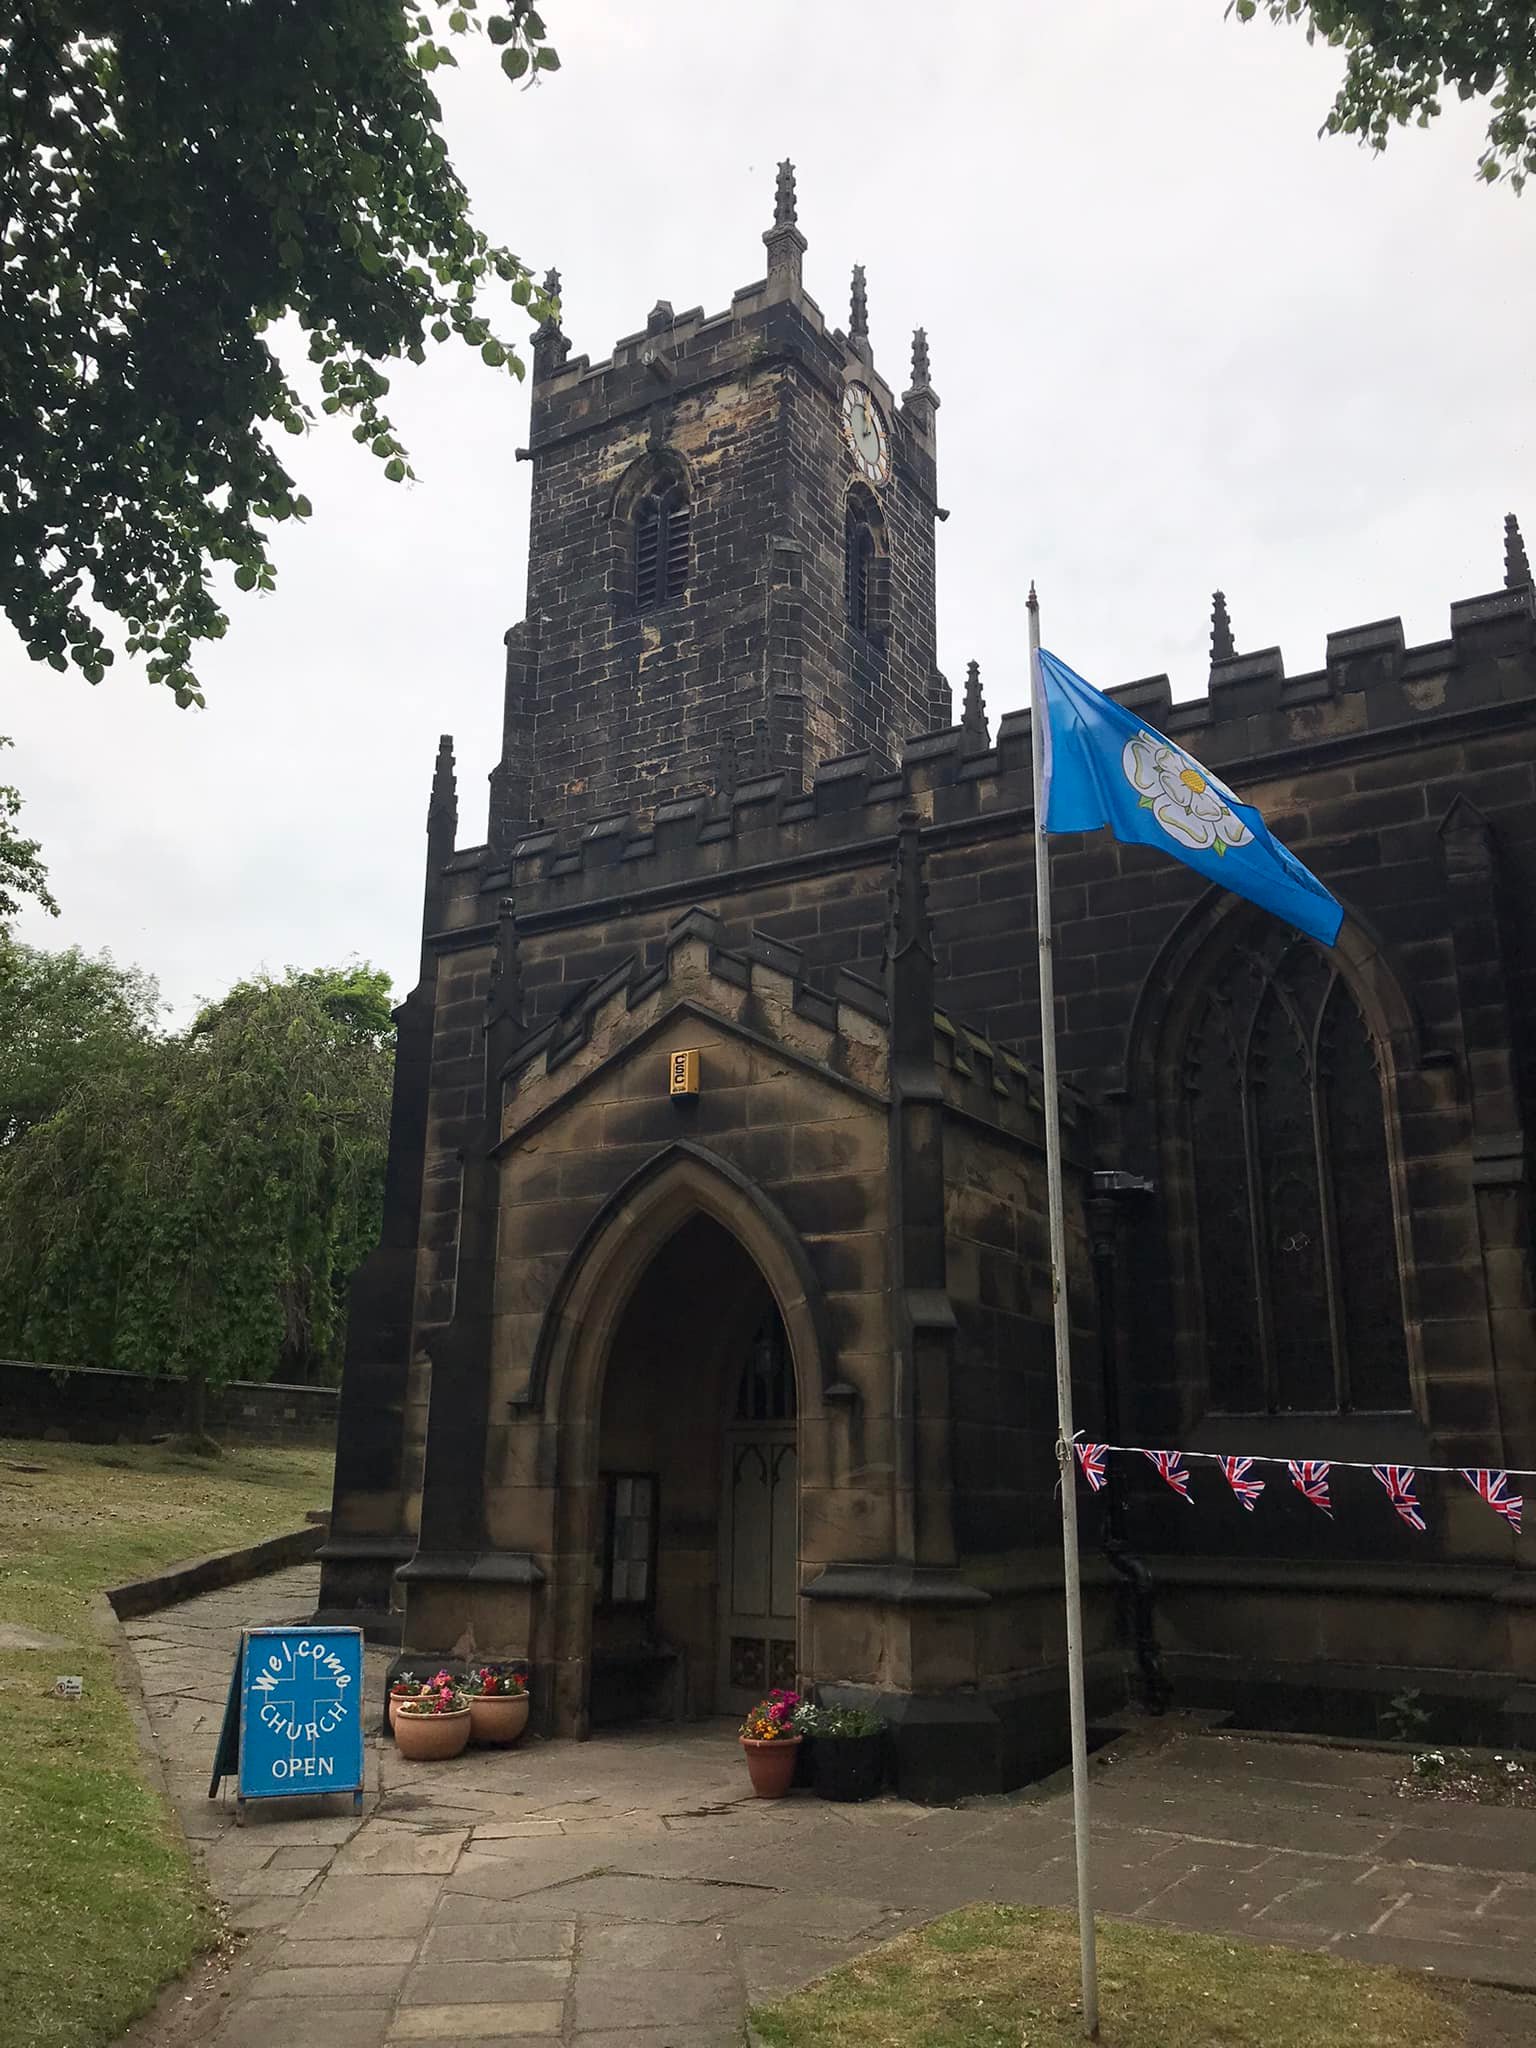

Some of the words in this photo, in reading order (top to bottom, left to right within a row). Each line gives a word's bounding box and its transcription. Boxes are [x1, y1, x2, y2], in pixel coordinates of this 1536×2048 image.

[251, 1641, 351, 1692] Welcome
[260, 1702, 348, 1740] CHURCH
[272, 1757, 334, 1778] OPEN
